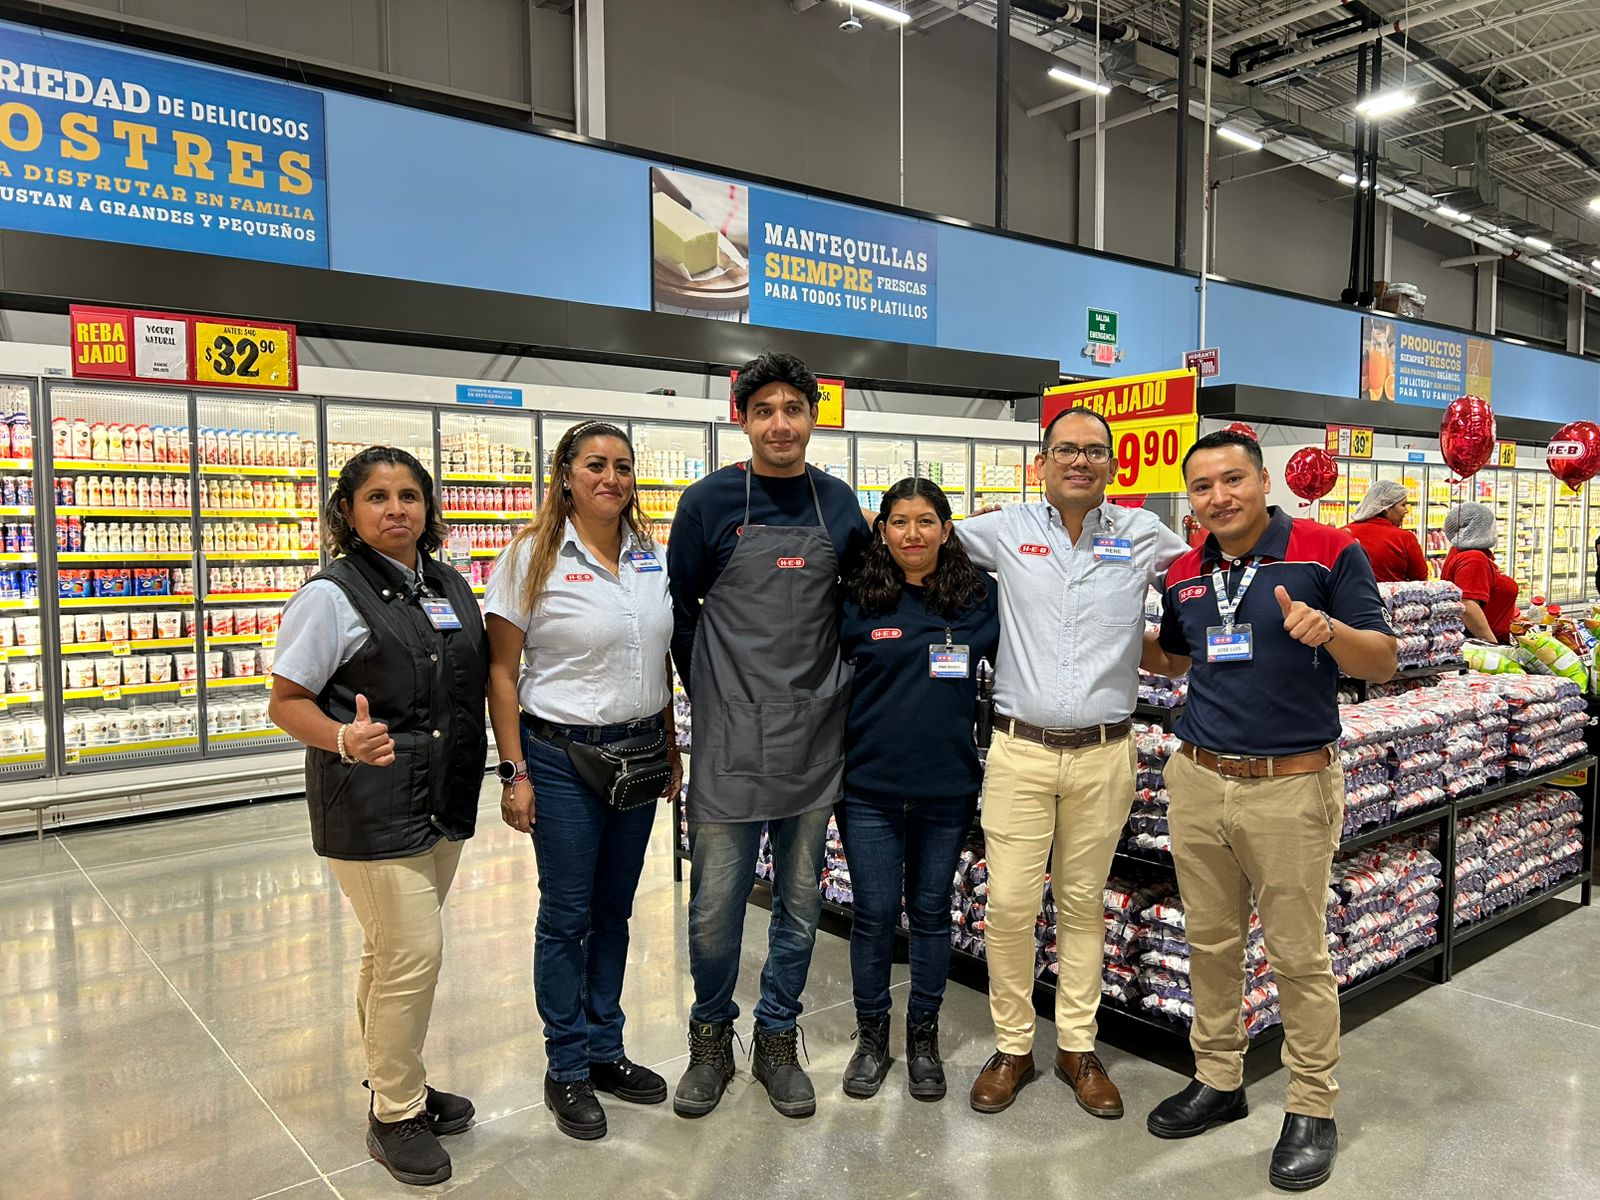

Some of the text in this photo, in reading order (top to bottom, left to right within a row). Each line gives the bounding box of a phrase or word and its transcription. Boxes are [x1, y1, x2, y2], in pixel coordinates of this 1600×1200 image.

[0, 59, 310, 141] RIEDAD DE DELICIOSOS
[0, 102, 314, 195] OSTRES
[24, 164, 187, 203] DISFRUTAR
[196, 191, 224, 208] EN
[230, 197, 315, 222] FAMILIA
[0, 186, 316, 243] USTAN A GRANDES Y PEQUEÑOS
[764, 222, 929, 272] MANTEQUILLAS
[764, 252, 927, 296] SIEMPRE FRESCAS
[764, 281, 928, 320] PARA TODOS TUS PLATILLOS
[1095, 313, 1110, 322] SALIDA
[1099, 323, 1106, 331] DE
[76, 322, 125, 343] REBA
[145, 336, 176, 346] NATURAL
[224, 327, 243, 336] ANTES:
[1089, 330, 1115, 342] EMERGENCIA
[78, 344, 127, 364] JADO
[1400, 334, 1462, 358] PRODUCTOS
[1400, 353, 1461, 370] SIEMPRE FRESCOS
[1399, 387, 1461, 401] PARA TU FAMILIA
[1143, 428, 1179, 467] 90
